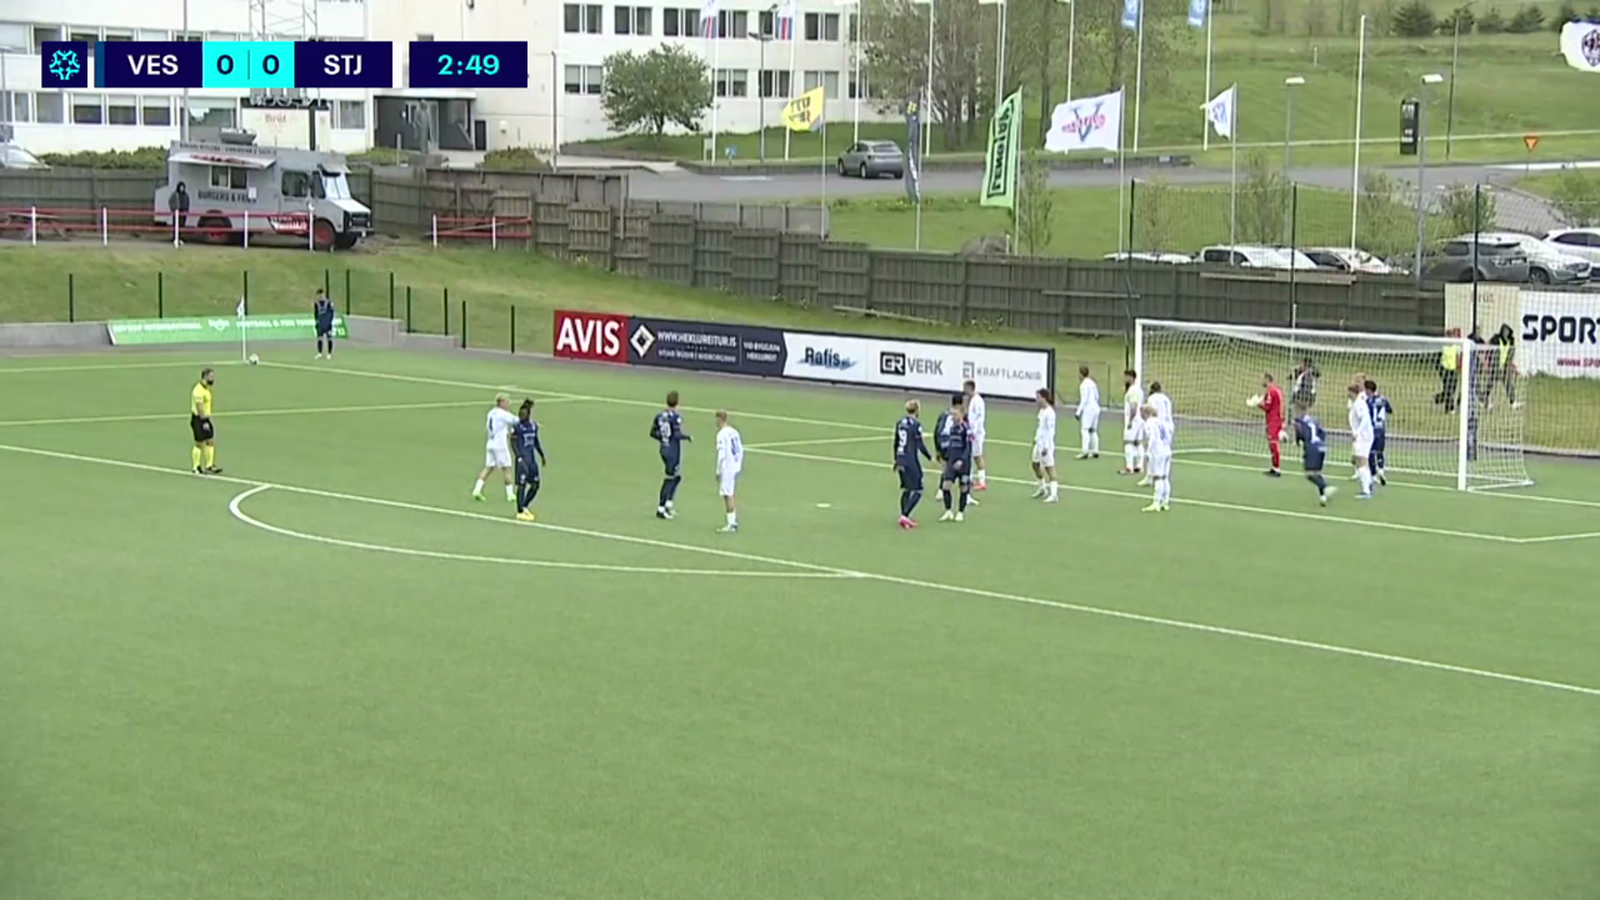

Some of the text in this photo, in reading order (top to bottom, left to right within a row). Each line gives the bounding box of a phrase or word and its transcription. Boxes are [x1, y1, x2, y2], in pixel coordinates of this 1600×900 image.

[556, 317, 620, 356] AVIS
[1522, 314, 1600, 344] SPOR
[908, 358, 943, 375] VERK
